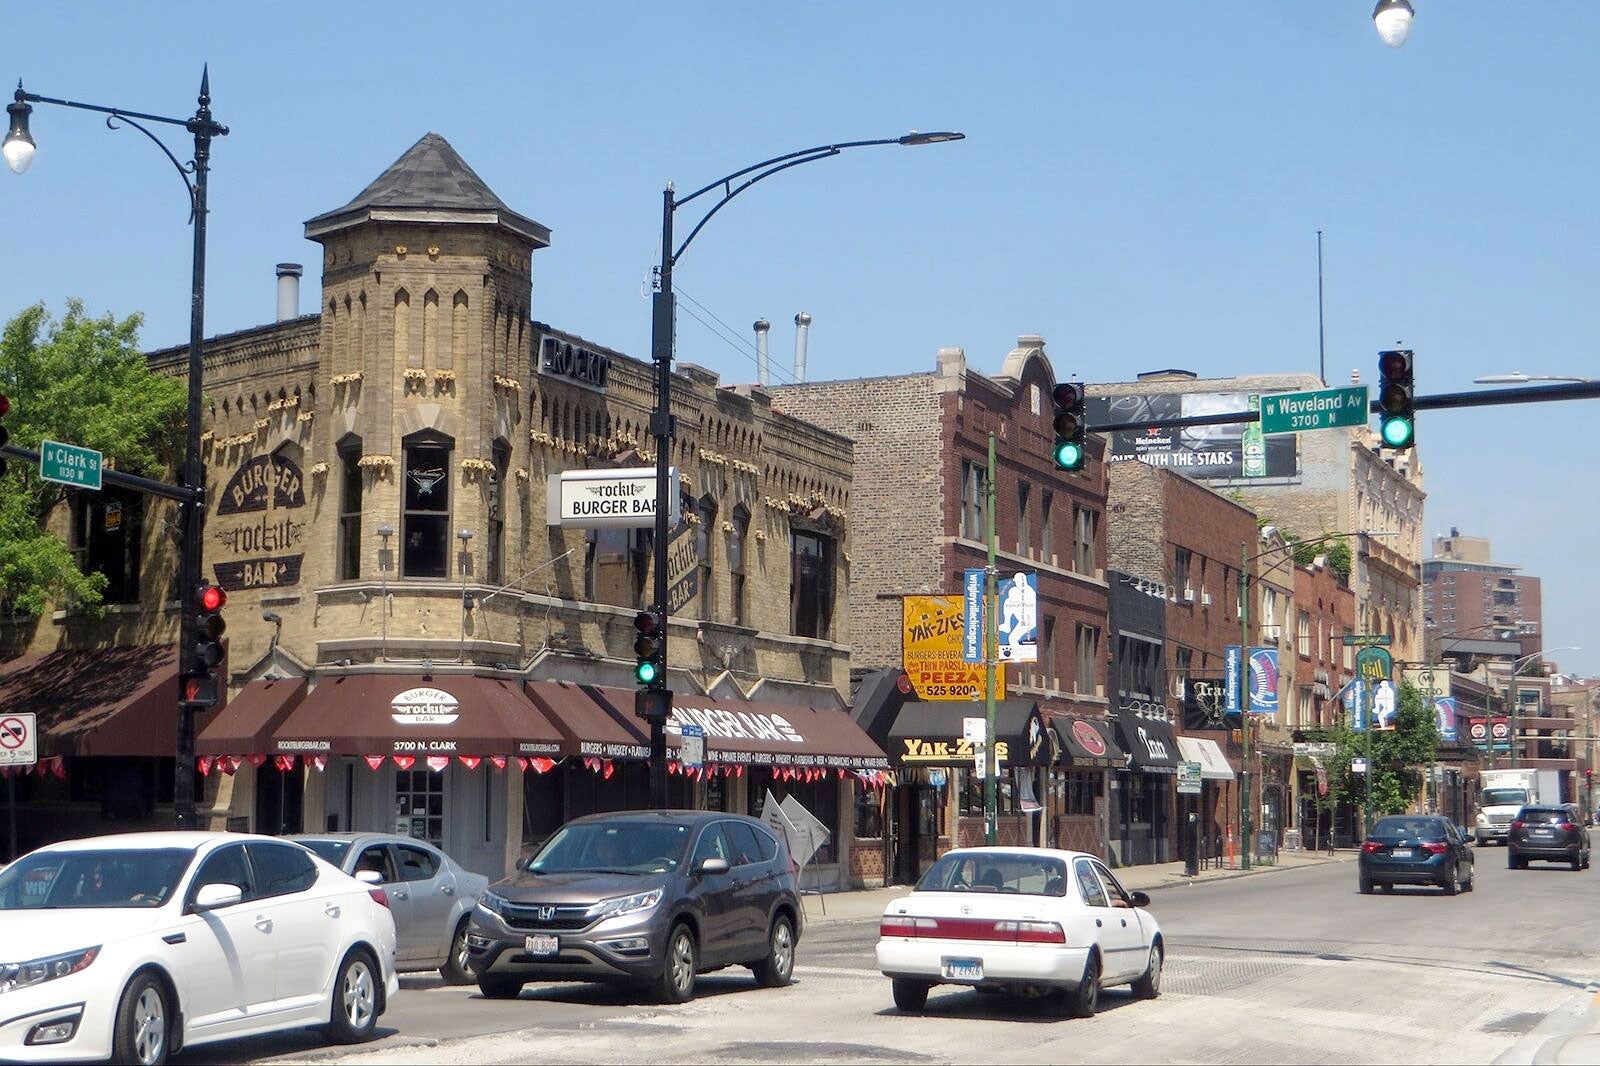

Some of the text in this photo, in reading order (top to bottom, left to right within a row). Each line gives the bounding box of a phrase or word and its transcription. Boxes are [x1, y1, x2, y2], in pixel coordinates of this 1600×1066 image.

[1266, 404, 1274, 416] W
[1279, 393, 1343, 414] Waveland
[1347, 395, 1361, 409] Av
[1291, 412, 1336, 427] 3700 N
[1135, 437, 1171, 445] Heineken
[47, 449, 54, 462] N
[56, 448, 86, 468] Clark
[1137, 453, 1168, 466] WITH
[1172, 453, 1194, 466] THE
[1197, 451, 1233, 465] STARS
[60, 466, 75, 479] 1130
[232, 463, 300, 507] BURGER
[599, 481, 636, 497] rockit
[573, 500, 627, 515] BURGER
[234, 513, 293, 553] rockit
[243, 561, 278, 586] BAR
[672, 580, 690, 611] BAR
[920, 661, 937, 671] THIN
[920, 672, 980, 684] PEEZA
[403, 690, 447, 701] BURGER
[405, 703, 447, 714] rockit
[672, 707, 755, 738] BURGER
[737, 711, 788, 741] BAR
[393, 741, 457, 750] 3700 N. CLARK
[580, 742, 603, 755] BURGERS
[607, 744, 628, 756] WHISKEY
[631, 746, 651, 758] FLATBREA
[903, 739, 1009, 756] YAK-ZS
